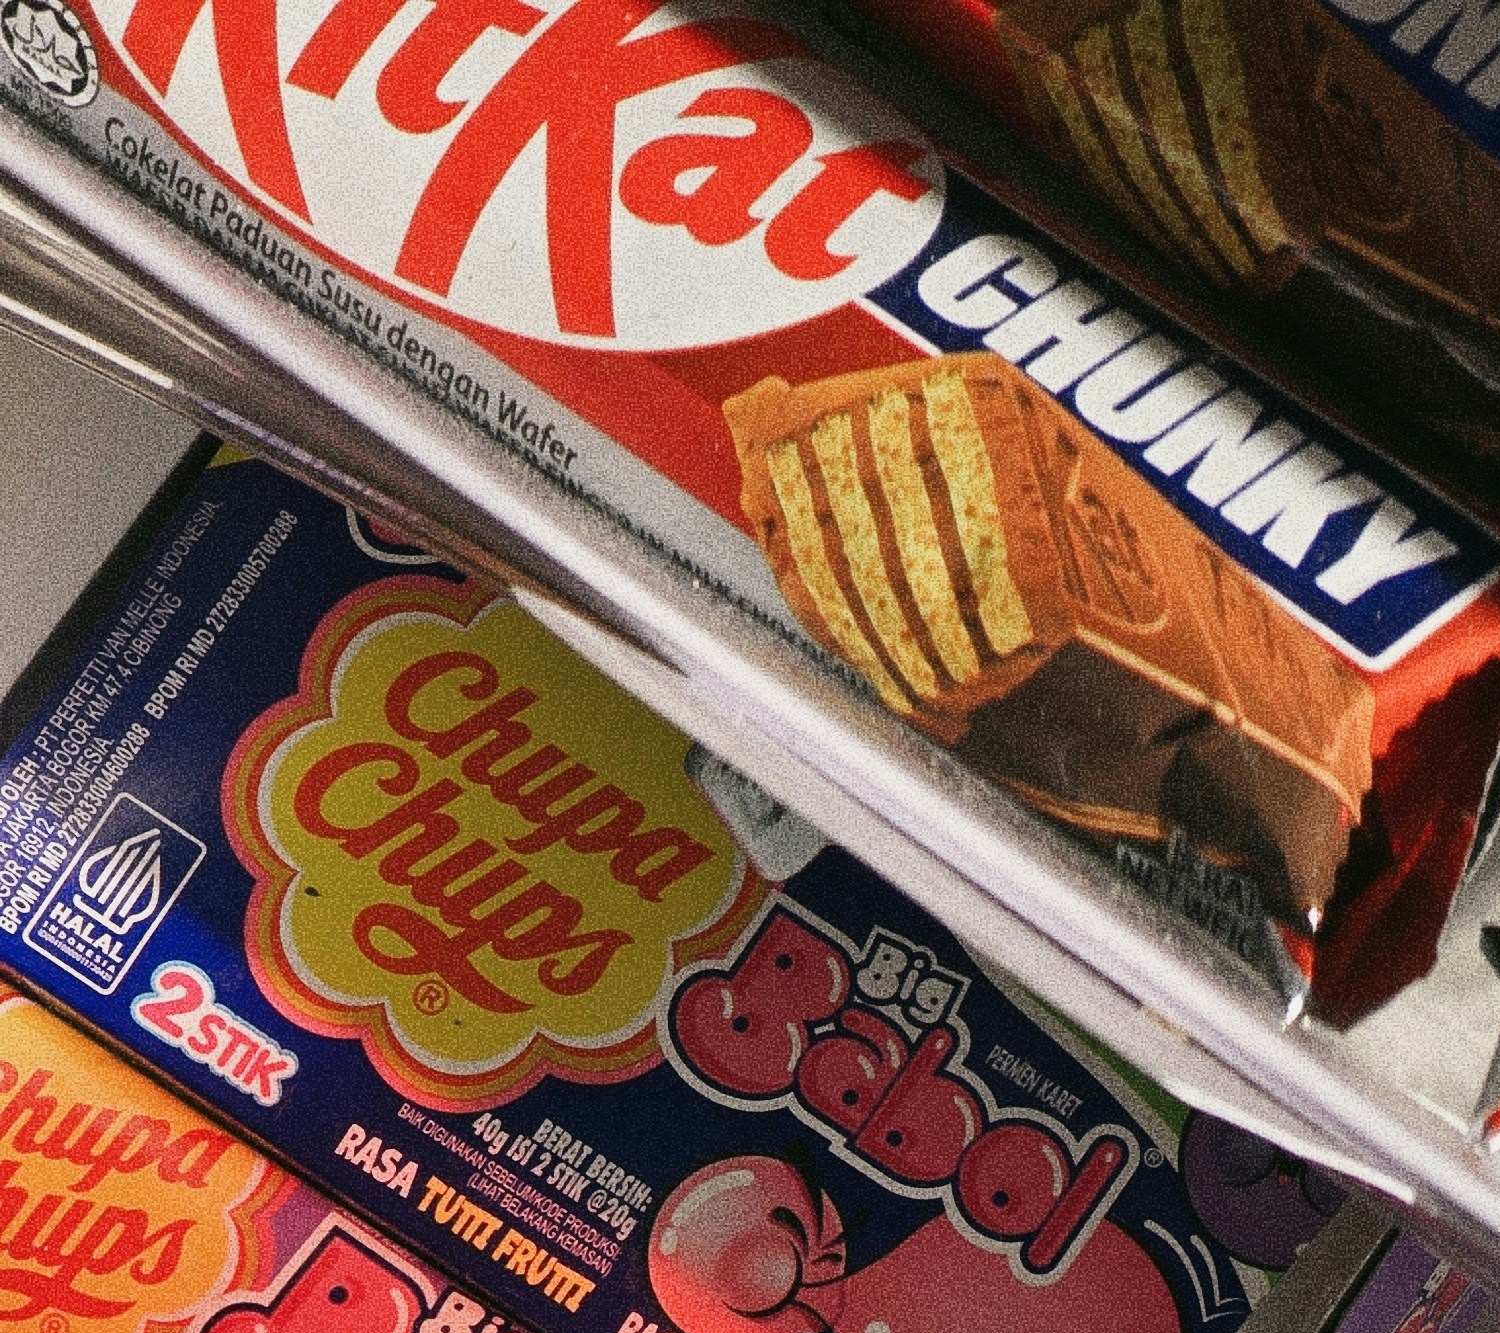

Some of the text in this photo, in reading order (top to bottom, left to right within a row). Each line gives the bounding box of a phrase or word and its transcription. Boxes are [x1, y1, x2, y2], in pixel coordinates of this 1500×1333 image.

[95, 116, 211, 206] Cokelat
[202, 193, 322, 284] Paduan
[312, 270, 388, 332] Susu
[379, 319, 499, 414] dengan
[487, 392, 582, 469] Wafer
[917, 232, 1459, 607] CHUNKY
[0, 758, 37, 800] OLEH
[35, 728, 58, 751] PT
[50, 657, 107, 729] PERFETTI
[99, 626, 129, 660] VAN
[121, 578, 162, 627] MELLE
[0, 693, 110, 840] JAKARTA BOGOR KM
[0, 883, 40, 932] BPOM
[26, 864, 53, 889] RI
[40, 842, 67, 870] MD
[144, 669, 186, 719] BPOM
[174, 650, 200, 675] RI
[188, 627, 215, 656] MD
[383, 650, 717, 903] Chupa
[43, 922, 115, 971] INDONESIA
[49, 903, 128, 961] HALAL
[292, 741, 635, 1014] Chups
[140, 972, 292, 1100] 2 STIK
[859, 954, 960, 1021] Big
[398, 1104, 425, 1127] BAIK
[423, 1122, 486, 1168] DIGUNAKAN
[675, 912, 1122, 1271] Babol
[985, 1045, 1081, 1118] PERMEN KARET
[335, 1123, 423, 1197] RASA
[414, 1177, 502, 1251] TUTTI
[491, 1230, 594, 1313] FRUTTI
[468, 1111, 639, 1240] 40g ISI 2 STIK @20g
[533, 1120, 655, 1211] BERAT BERSIH:
[500, 1195, 557, 1237] BELAKANG
[555, 1232, 612, 1276] KEMASAN)
